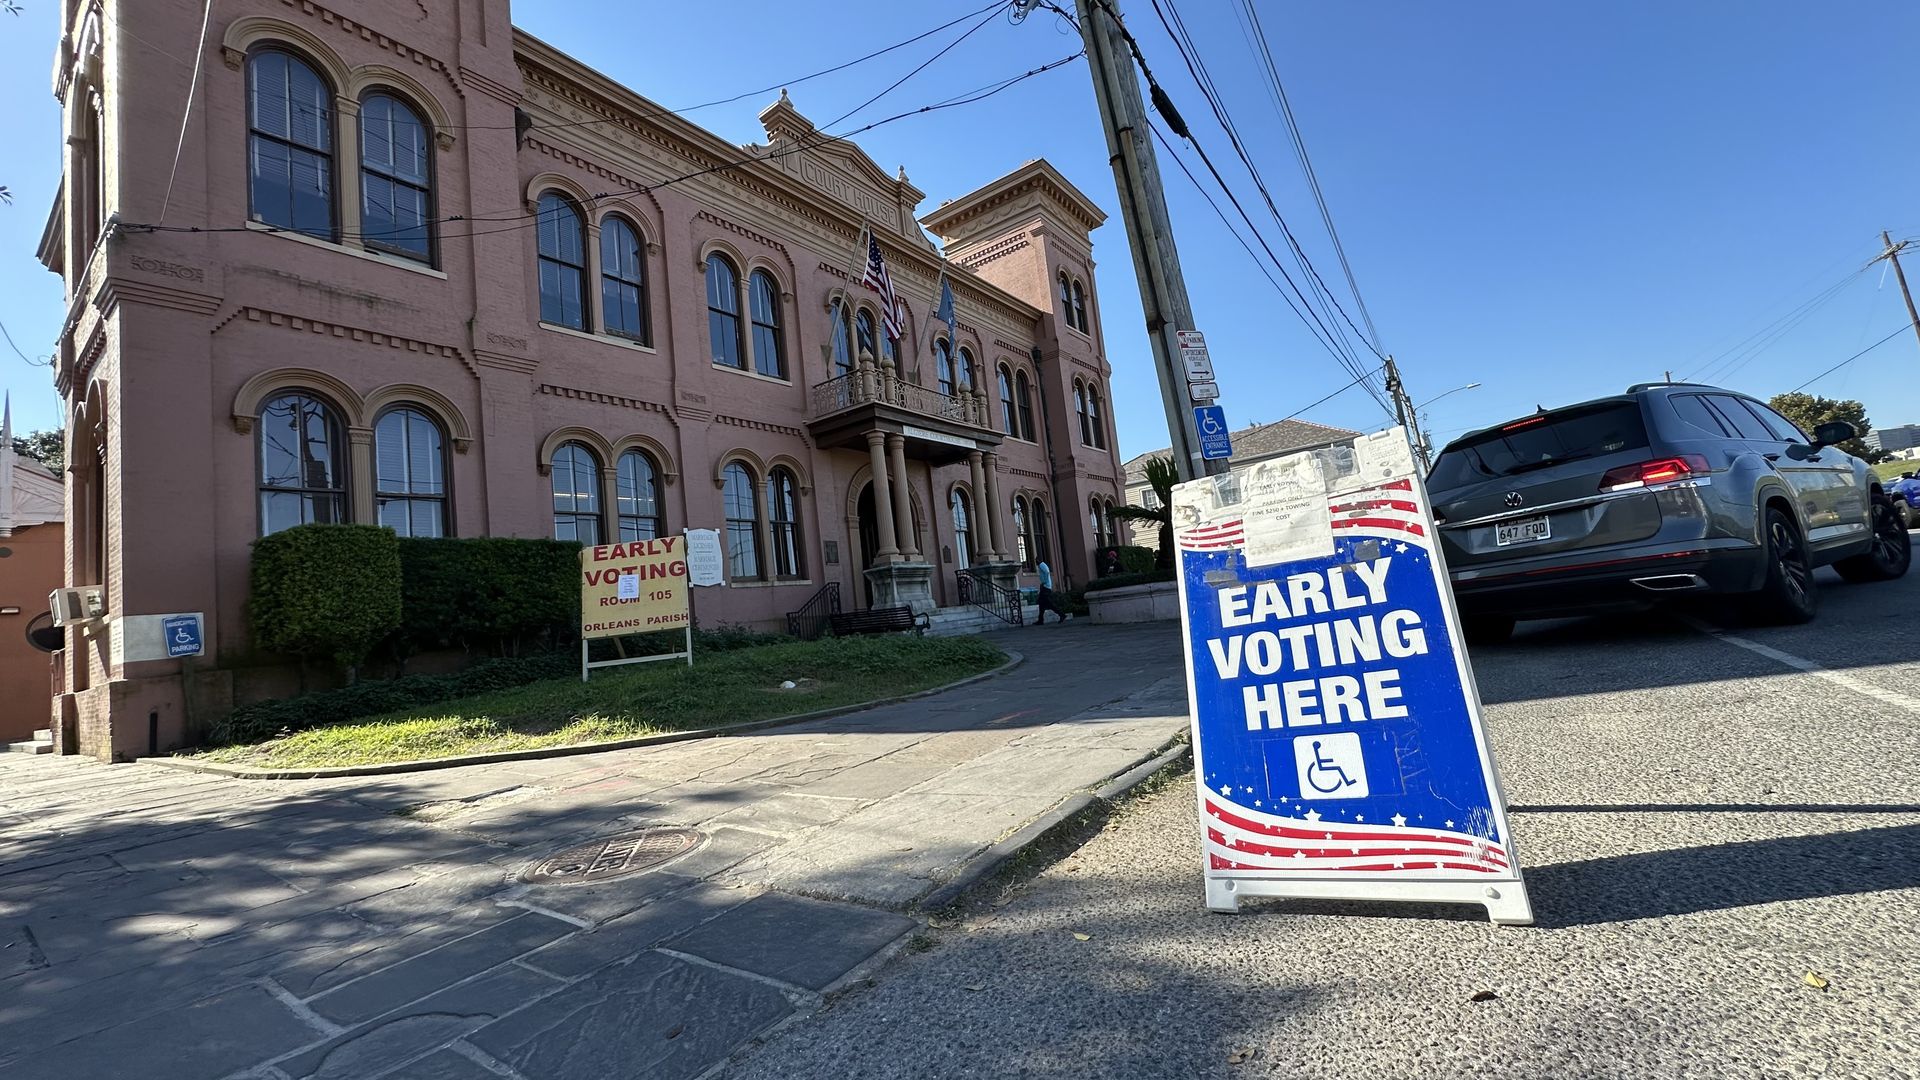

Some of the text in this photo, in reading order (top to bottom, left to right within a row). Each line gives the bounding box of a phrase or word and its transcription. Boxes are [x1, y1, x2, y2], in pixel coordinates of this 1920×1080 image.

[804, 161, 896, 227] COURT HOUSE
[1201, 433, 1228, 442] ACCESSIBLE
[1204, 440, 1229, 450] ENTRANCE
[1285, 502, 1310, 511] TOWING
[1500, 527, 1519, 540] 647
[1525, 522, 1546, 536] FQD
[593, 537, 677, 562] EARLY
[584, 560, 686, 587] VOTING
[600, 589, 672, 607] ROOM 105
[1217, 556, 1393, 629] EARLY
[584, 613, 689, 632] ORLEANS PARISH
[171, 643, 200, 653] PARKING
[1206, 608, 1429, 680] VOTING
[1242, 668, 1409, 732] HERE
